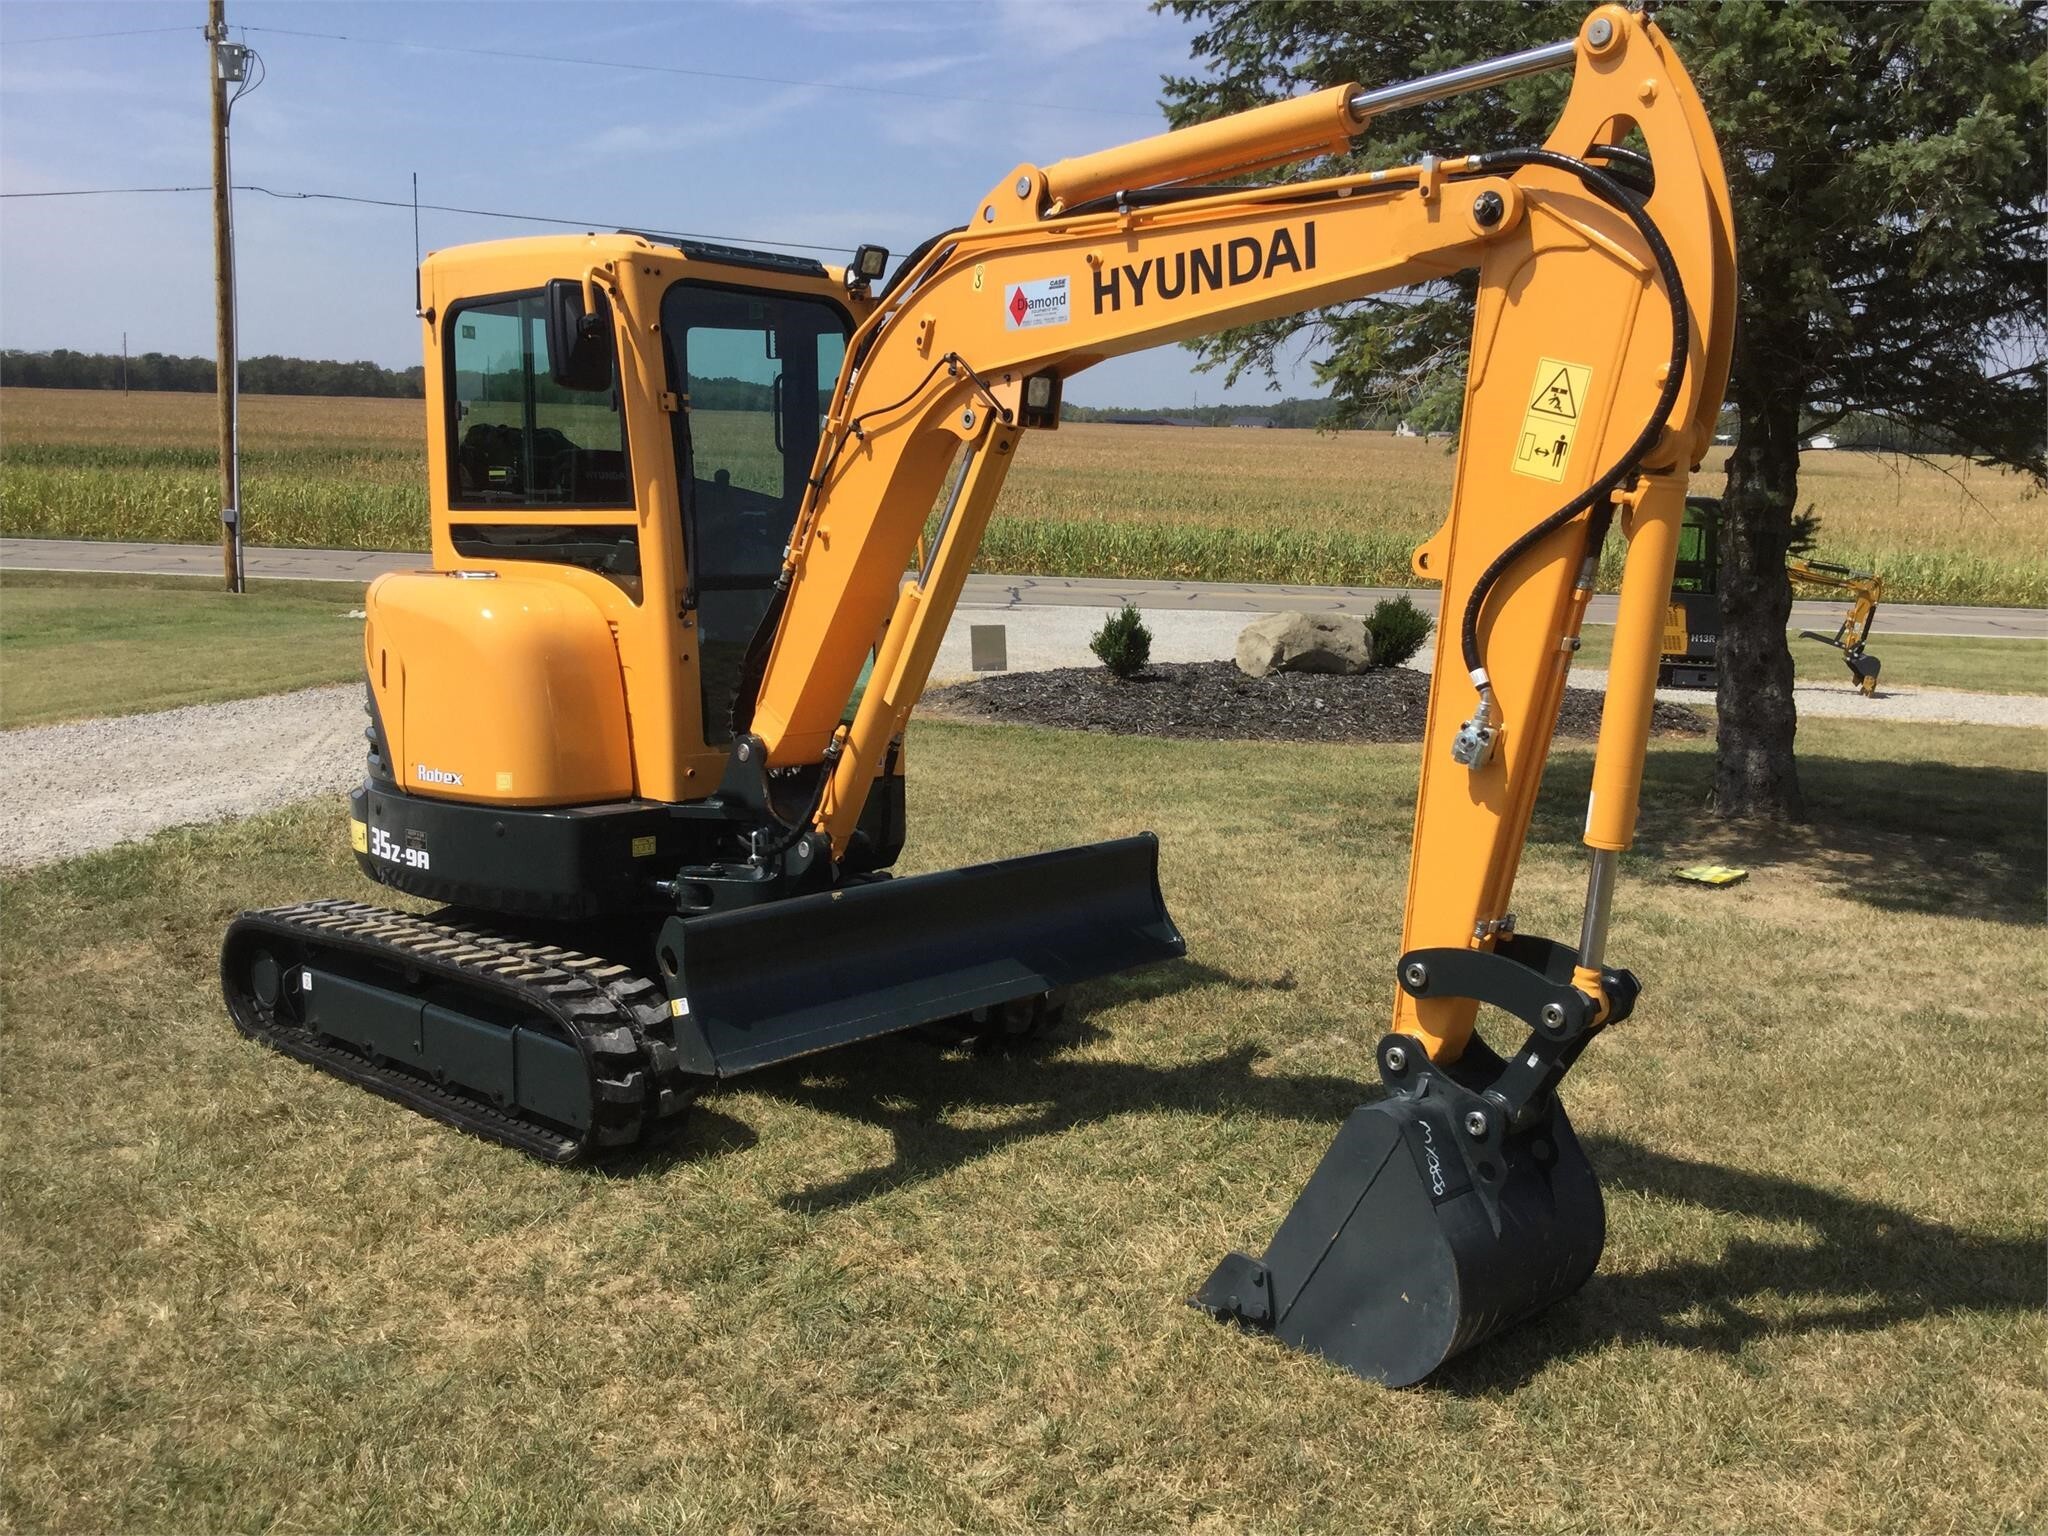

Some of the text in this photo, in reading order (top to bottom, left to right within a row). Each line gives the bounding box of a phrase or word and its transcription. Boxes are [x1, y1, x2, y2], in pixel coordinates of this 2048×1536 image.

[1093, 221, 1316, 315] HYUNDAI
[1049, 279, 1066, 287] CASE
[1017, 291, 1066, 311] Diamond
[1691, 633, 1716, 644] H13R
[416, 763, 465, 787] Robex
